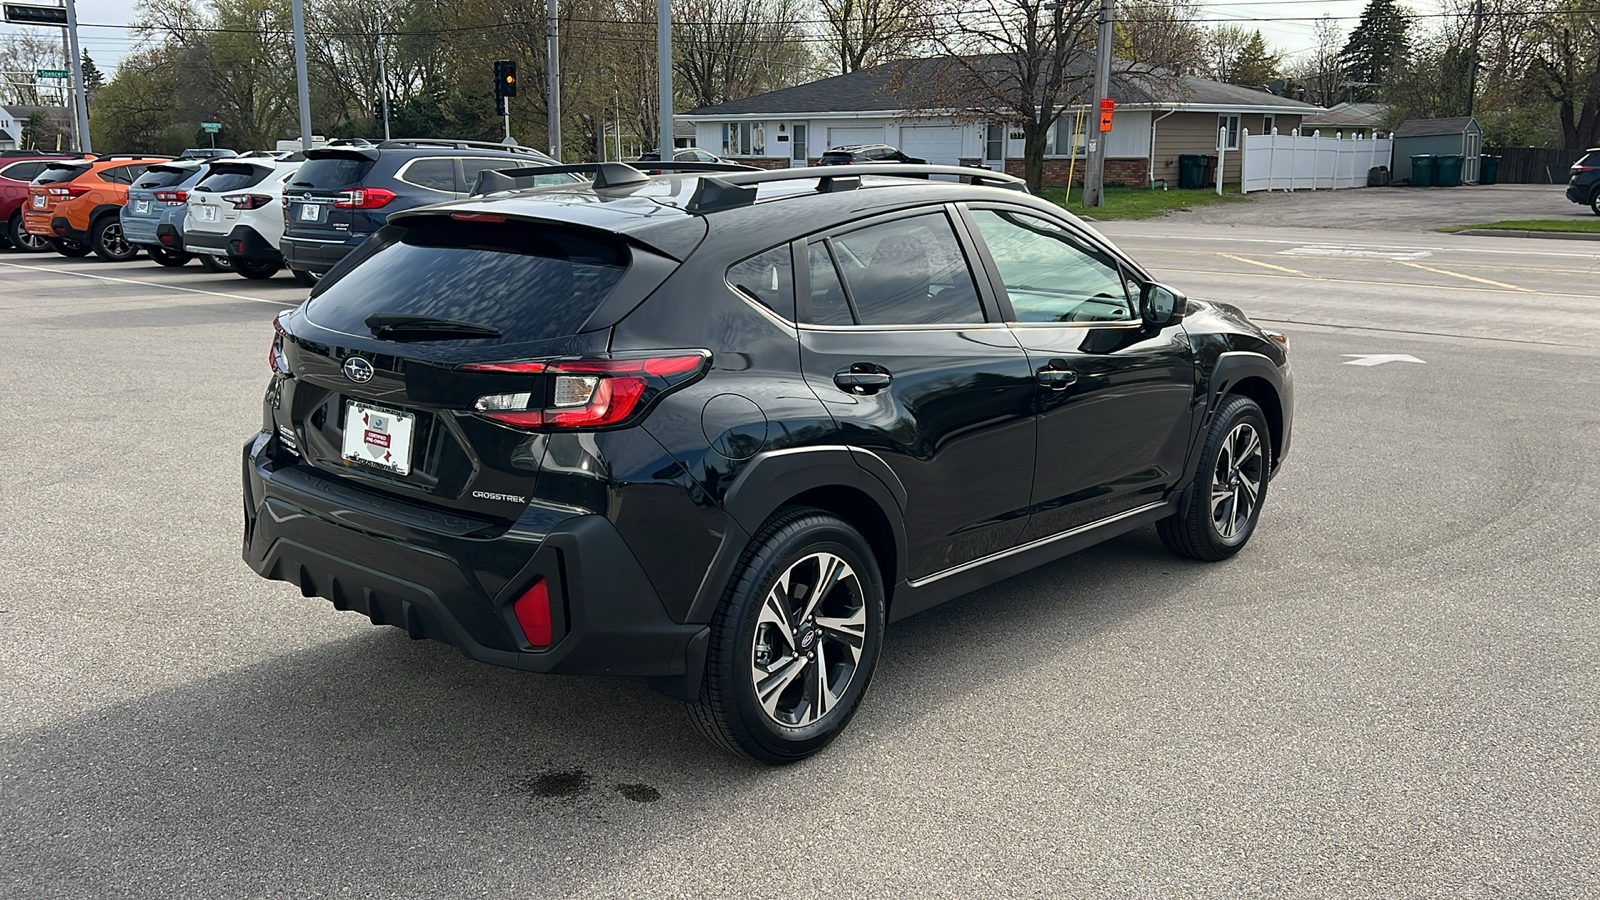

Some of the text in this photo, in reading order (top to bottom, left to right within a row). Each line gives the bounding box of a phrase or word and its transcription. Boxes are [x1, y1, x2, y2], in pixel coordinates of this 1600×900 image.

[41, 70, 64, 78] Spencer
[368, 432, 387, 441] CERTIFIED
[366, 437, 388, 447] PRE-OWNED
[472, 490, 526, 504] CROSSTREK
